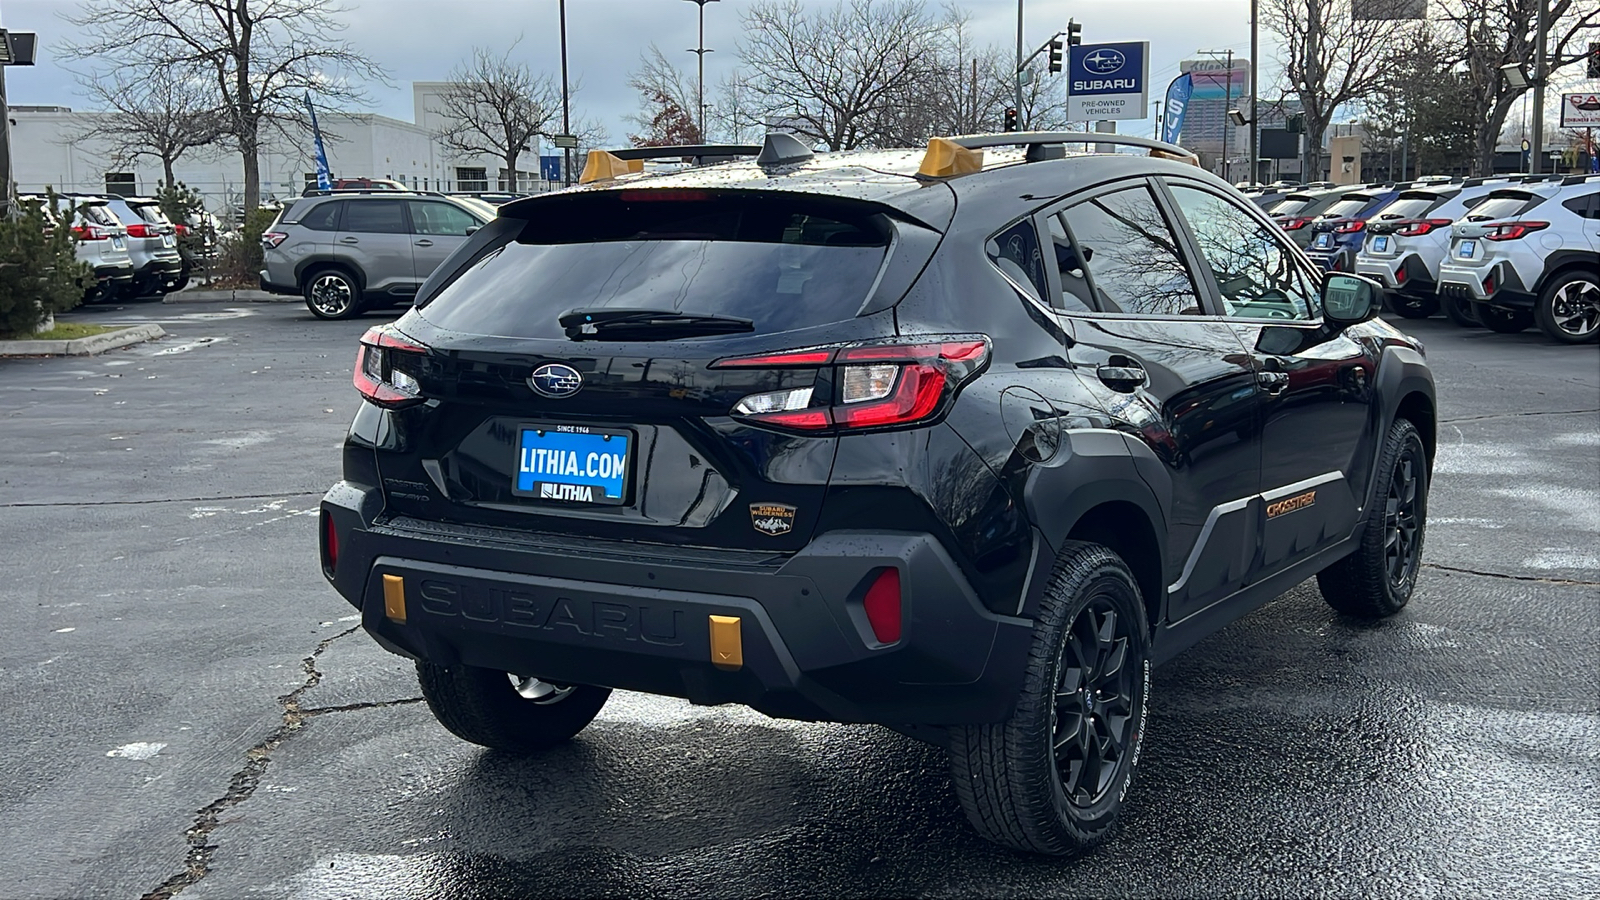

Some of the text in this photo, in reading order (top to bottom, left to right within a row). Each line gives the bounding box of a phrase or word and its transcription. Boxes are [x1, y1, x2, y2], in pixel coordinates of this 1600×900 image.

[1073, 79, 1135, 91] SUBARU
[1081, 100, 1125, 108] PRE-OWNED
[557, 425, 590, 434] SINCE 1946
[520, 448, 626, 480] LITHIA.COM
[553, 484, 593, 502] LITHIA
[1266, 491, 1316, 517] CROSSTREK
[420, 579, 684, 646] SUBARU
